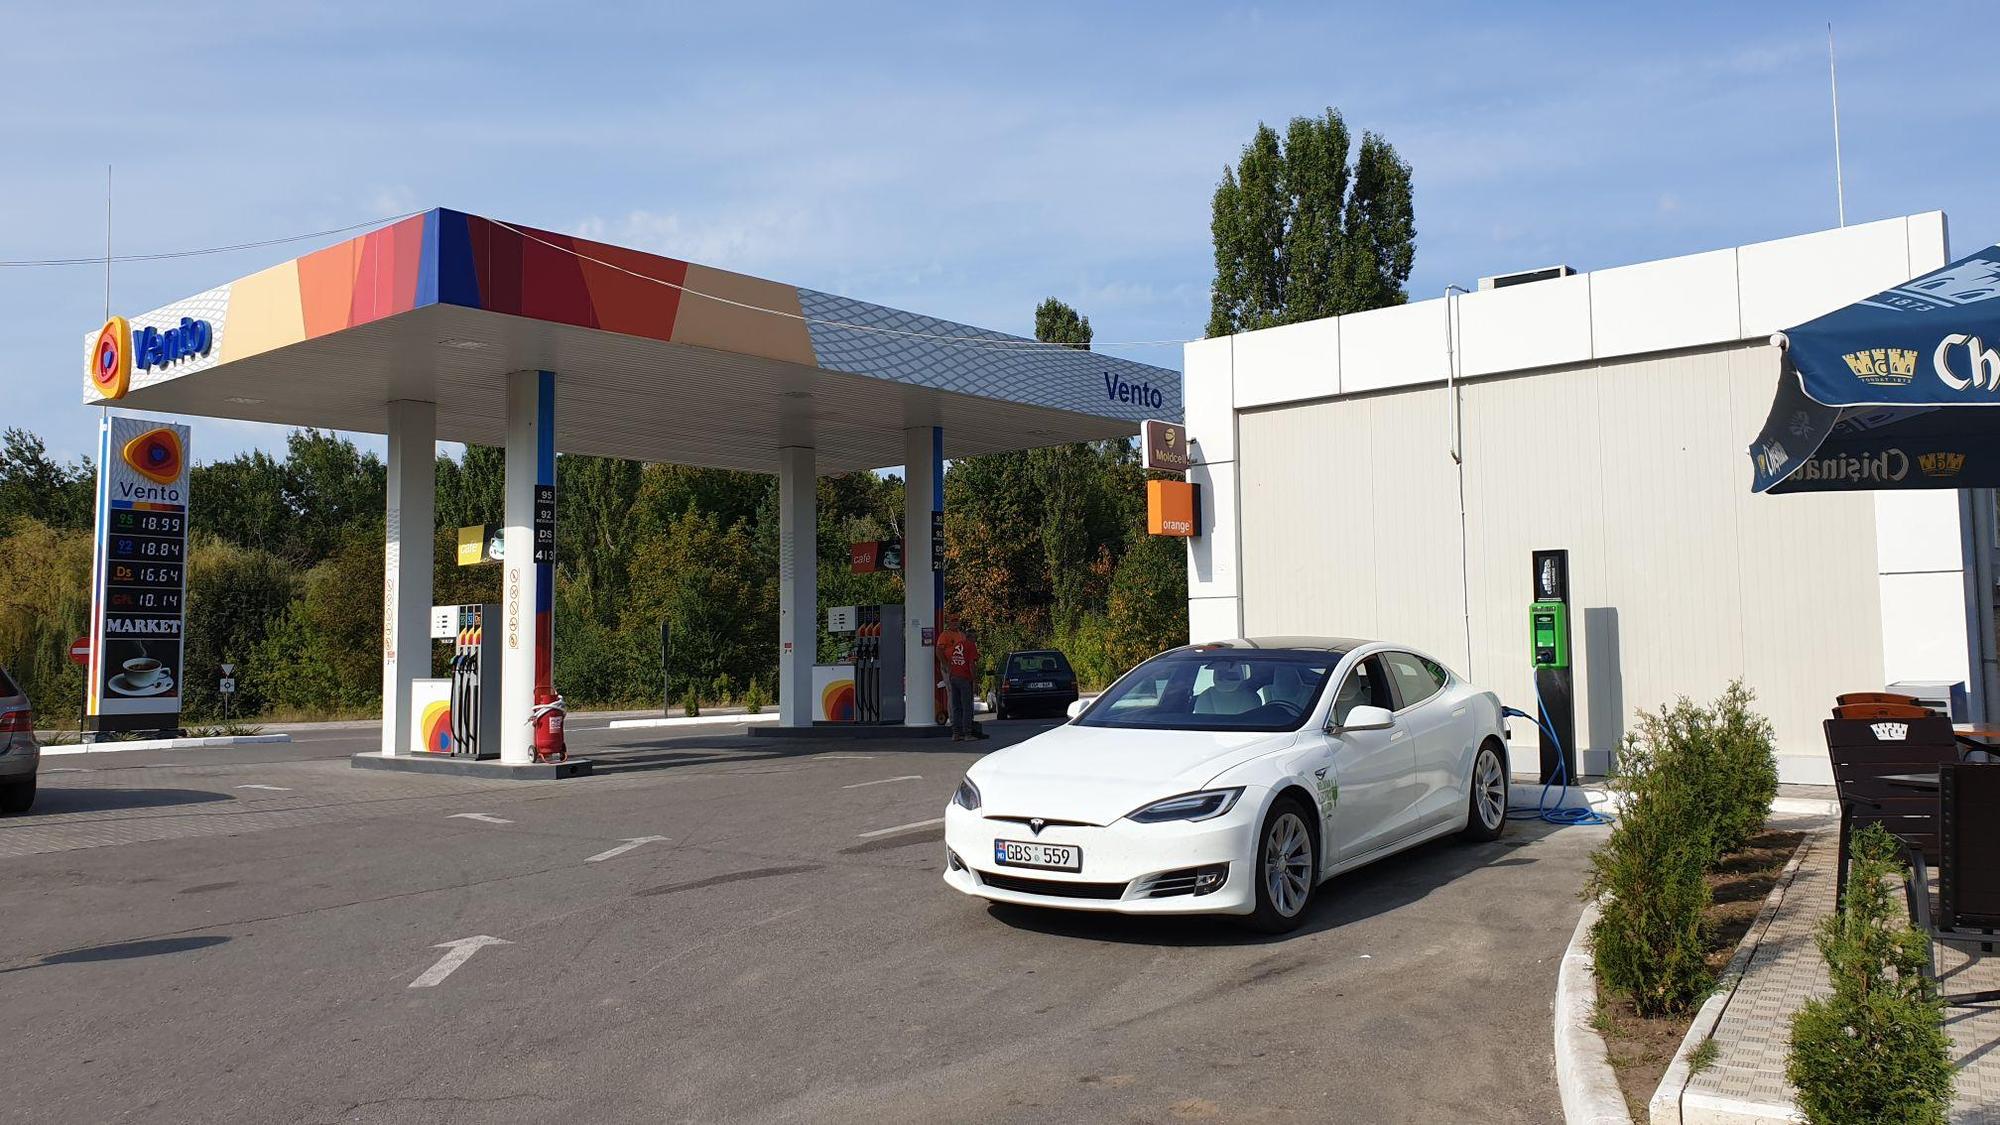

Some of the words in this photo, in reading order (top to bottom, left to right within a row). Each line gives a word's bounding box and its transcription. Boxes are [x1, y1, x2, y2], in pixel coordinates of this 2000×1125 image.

[1886, 296, 1936, 312] 1873
[132, 317, 213, 372] Vento
[1103, 371, 1163, 409] Vento
[120, 482, 179, 501] Vento
[541, 490, 552, 499] 95
[541, 510, 552, 519] 92
[142, 517, 180, 532] 18.99
[1163, 519, 1191, 534] orange
[540, 529, 552, 539] DS
[141, 542, 180, 556] 18.84
[116, 566, 132, 577] Ds
[140, 568, 179, 582] 16.64
[107, 618, 181, 634] MARKET
[1006, 843, 1032, 862] GBS
[1043, 847, 1071, 865] 559
